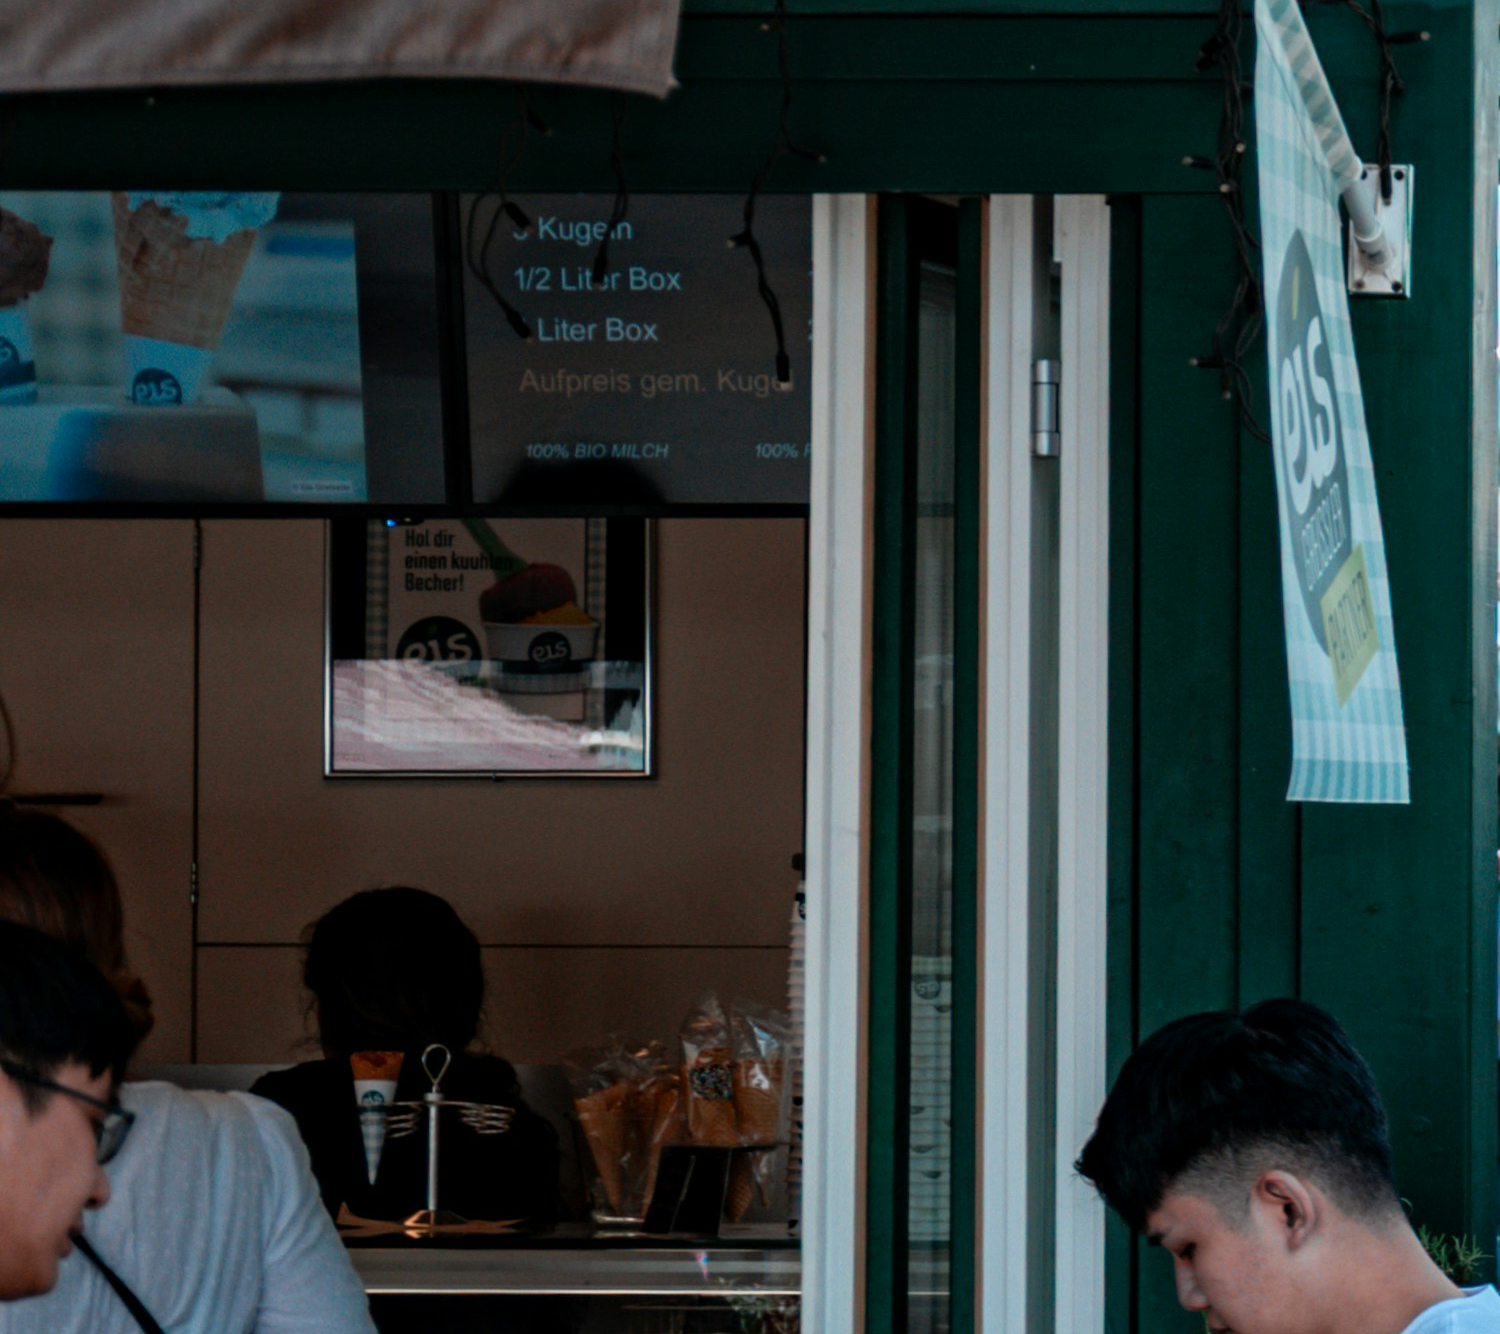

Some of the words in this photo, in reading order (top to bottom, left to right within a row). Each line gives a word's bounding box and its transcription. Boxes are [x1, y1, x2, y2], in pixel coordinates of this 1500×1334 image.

[513, 267, 550, 291] 1/2
[628, 267, 682, 292] Box
[538, 318, 597, 342] Liter
[605, 318, 658, 342] Box
[519, 369, 631, 398] Aufpreis
[640, 373, 706, 399] gem.
[575, 443, 606, 460] BIO
[611, 443, 669, 460] MILCH
[755, 443, 799, 459] 100%
[405, 529, 429, 548] Hol
[434, 529, 455, 548] dir
[405, 551, 447, 570] einen
[405, 572, 464, 592] Becher!
